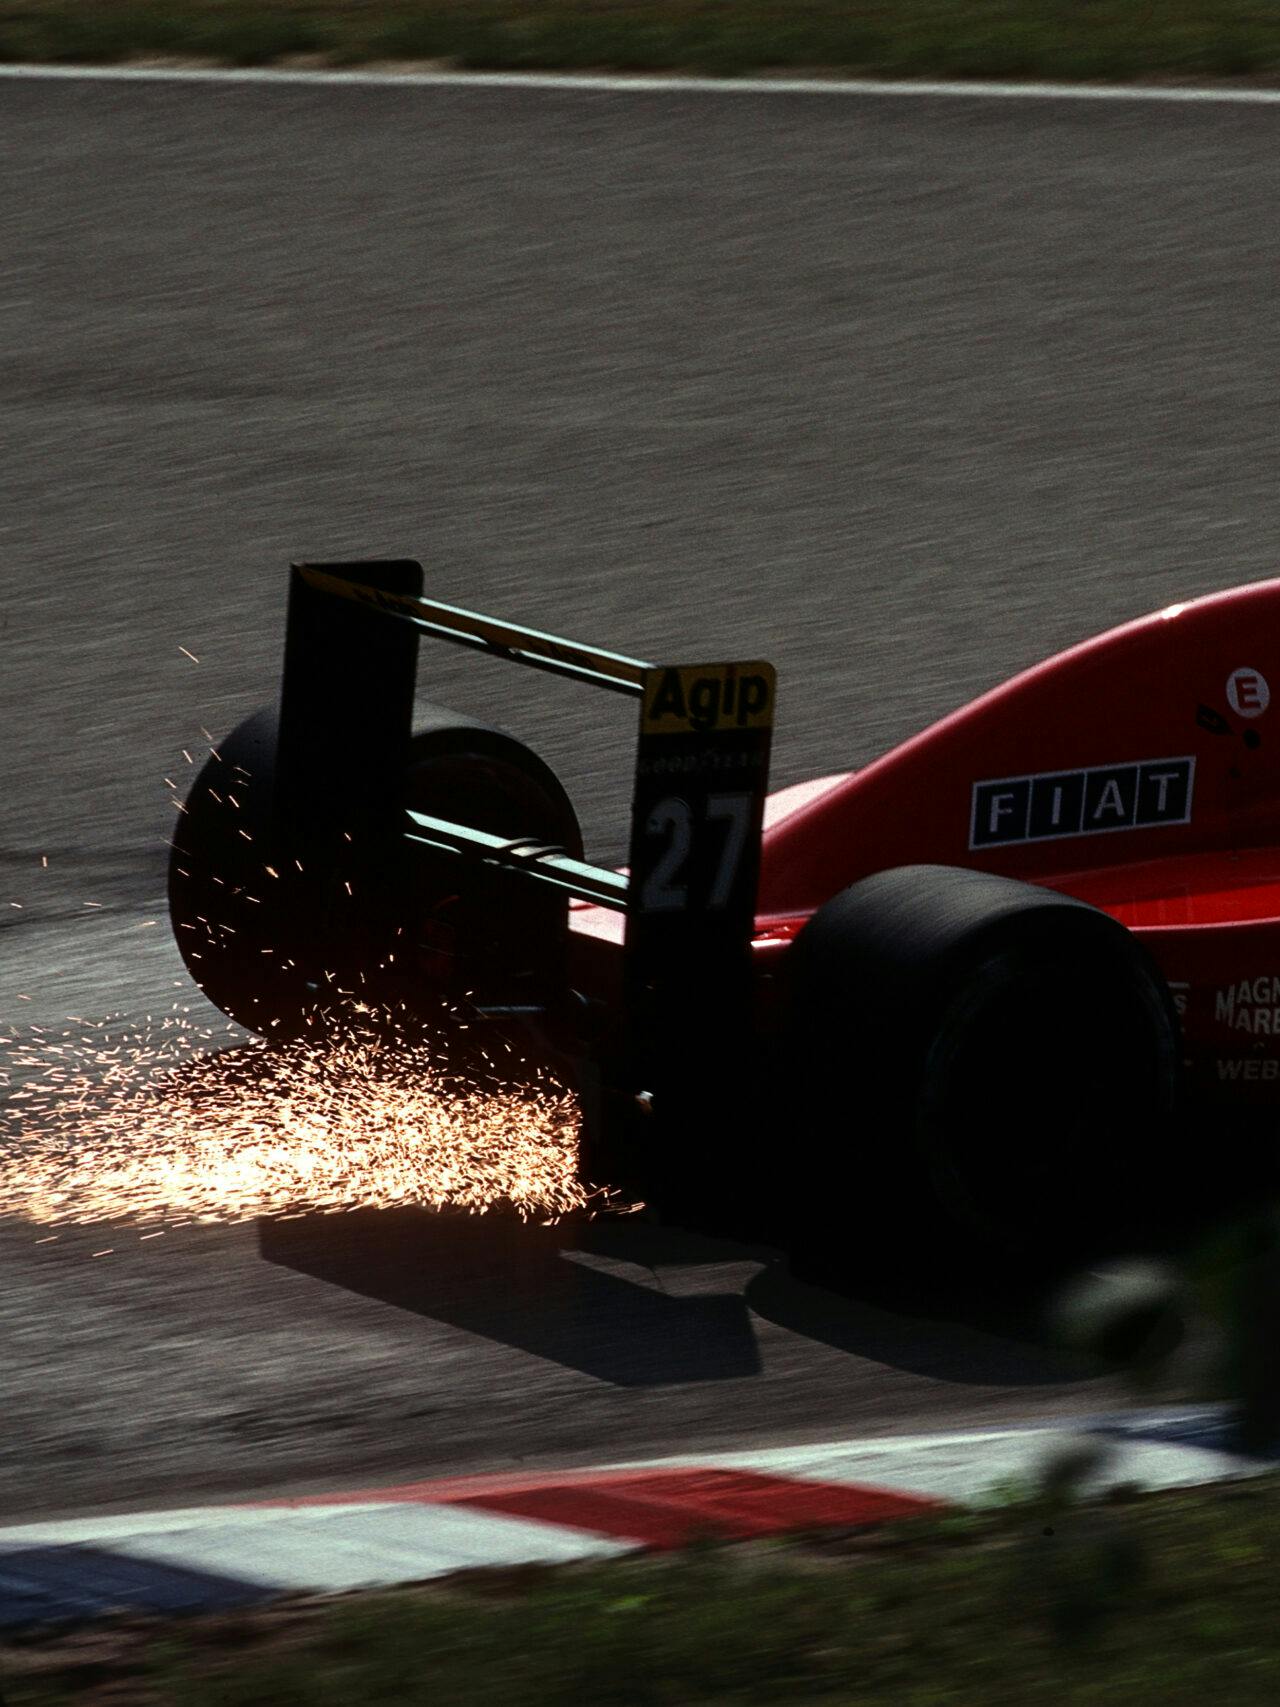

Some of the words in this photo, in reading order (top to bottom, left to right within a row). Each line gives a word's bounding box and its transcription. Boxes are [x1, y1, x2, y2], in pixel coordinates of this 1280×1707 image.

[650, 665, 768, 730] Agip
[1235, 675, 1260, 709] E
[989, 771, 1180, 834] FIAT
[638, 791, 754, 913] 27
